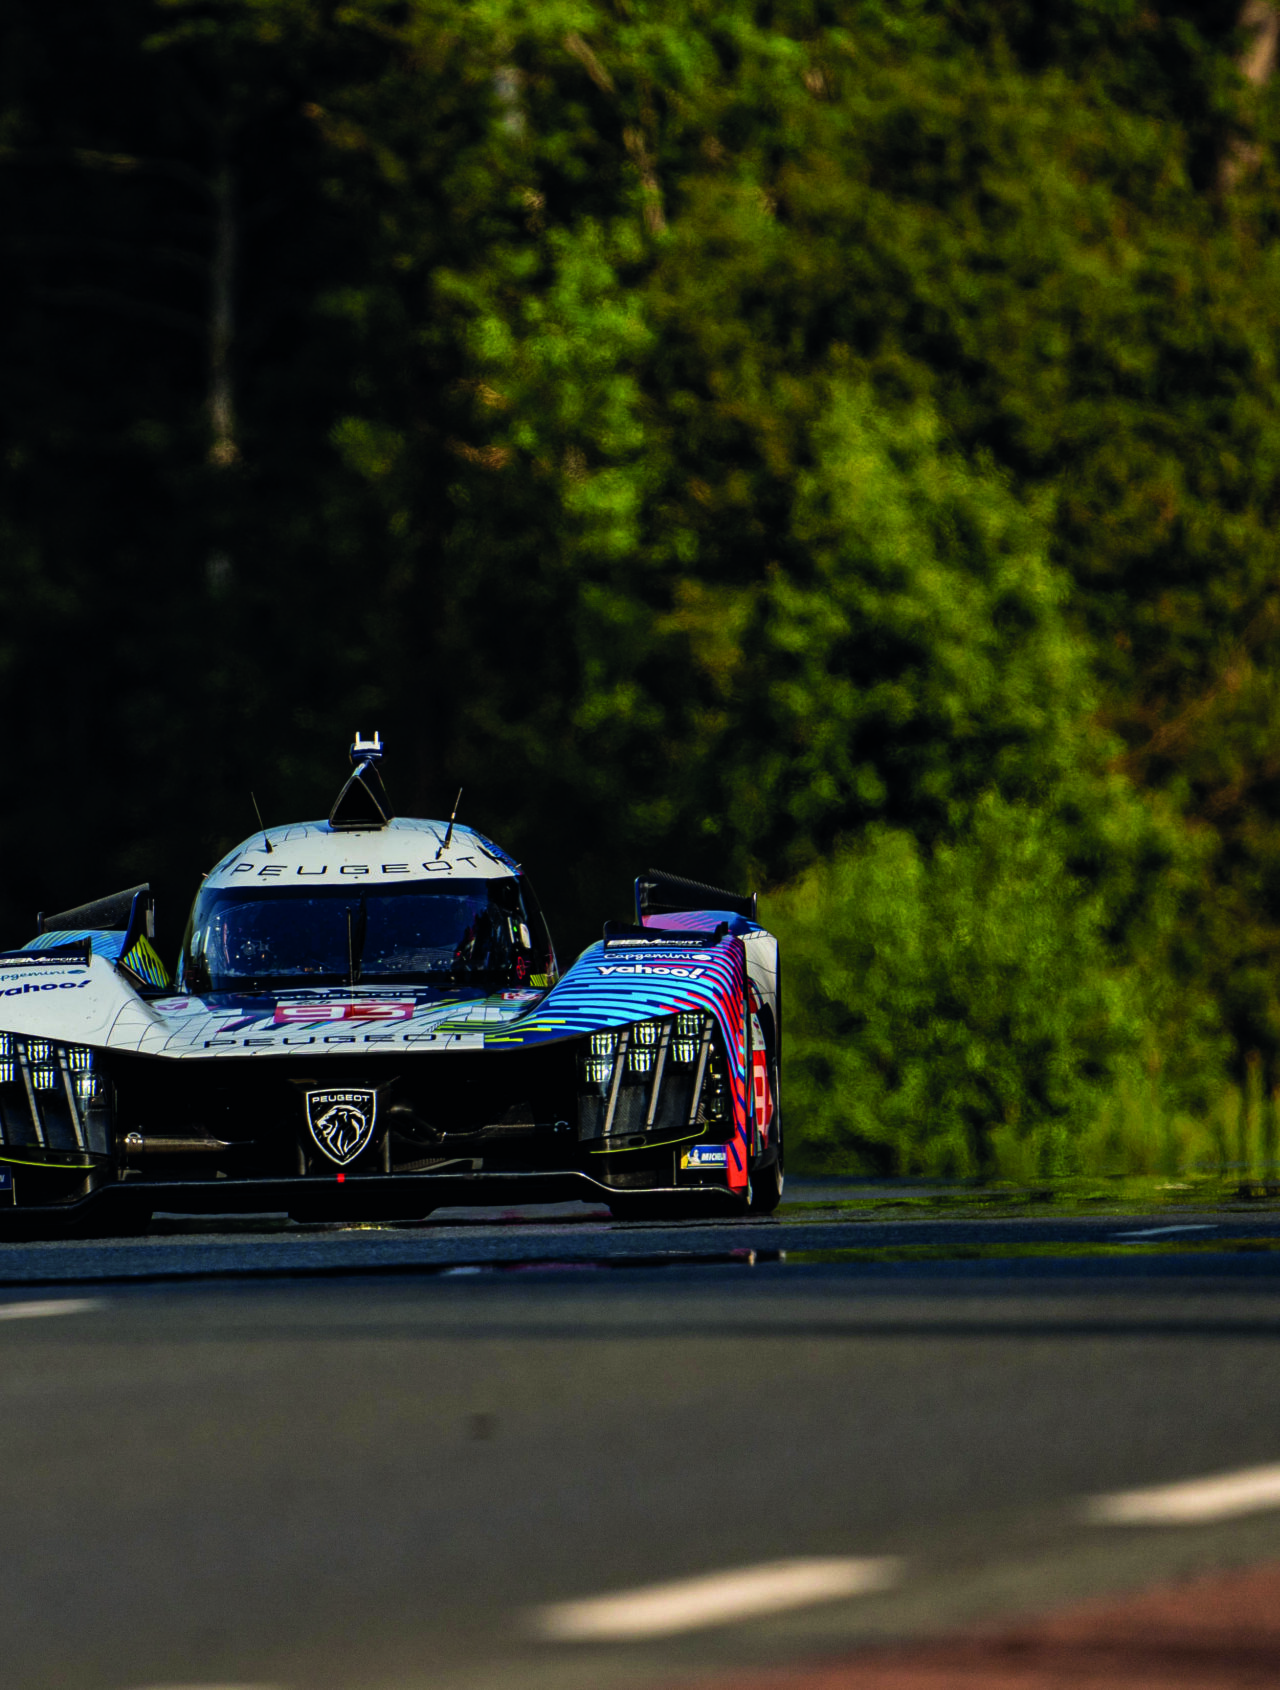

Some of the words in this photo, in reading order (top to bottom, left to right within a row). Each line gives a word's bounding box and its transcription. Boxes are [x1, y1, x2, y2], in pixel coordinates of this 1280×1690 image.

[230, 856, 478, 876] PEUGEOT
[604, 952, 691, 960] Capgemini
[598, 964, 705, 979] yahoo!
[282, 1004, 406, 1021] 93
[204, 1033, 475, 1048] PEUGEOT
[312, 1094, 370, 1103] PEUGEOT
